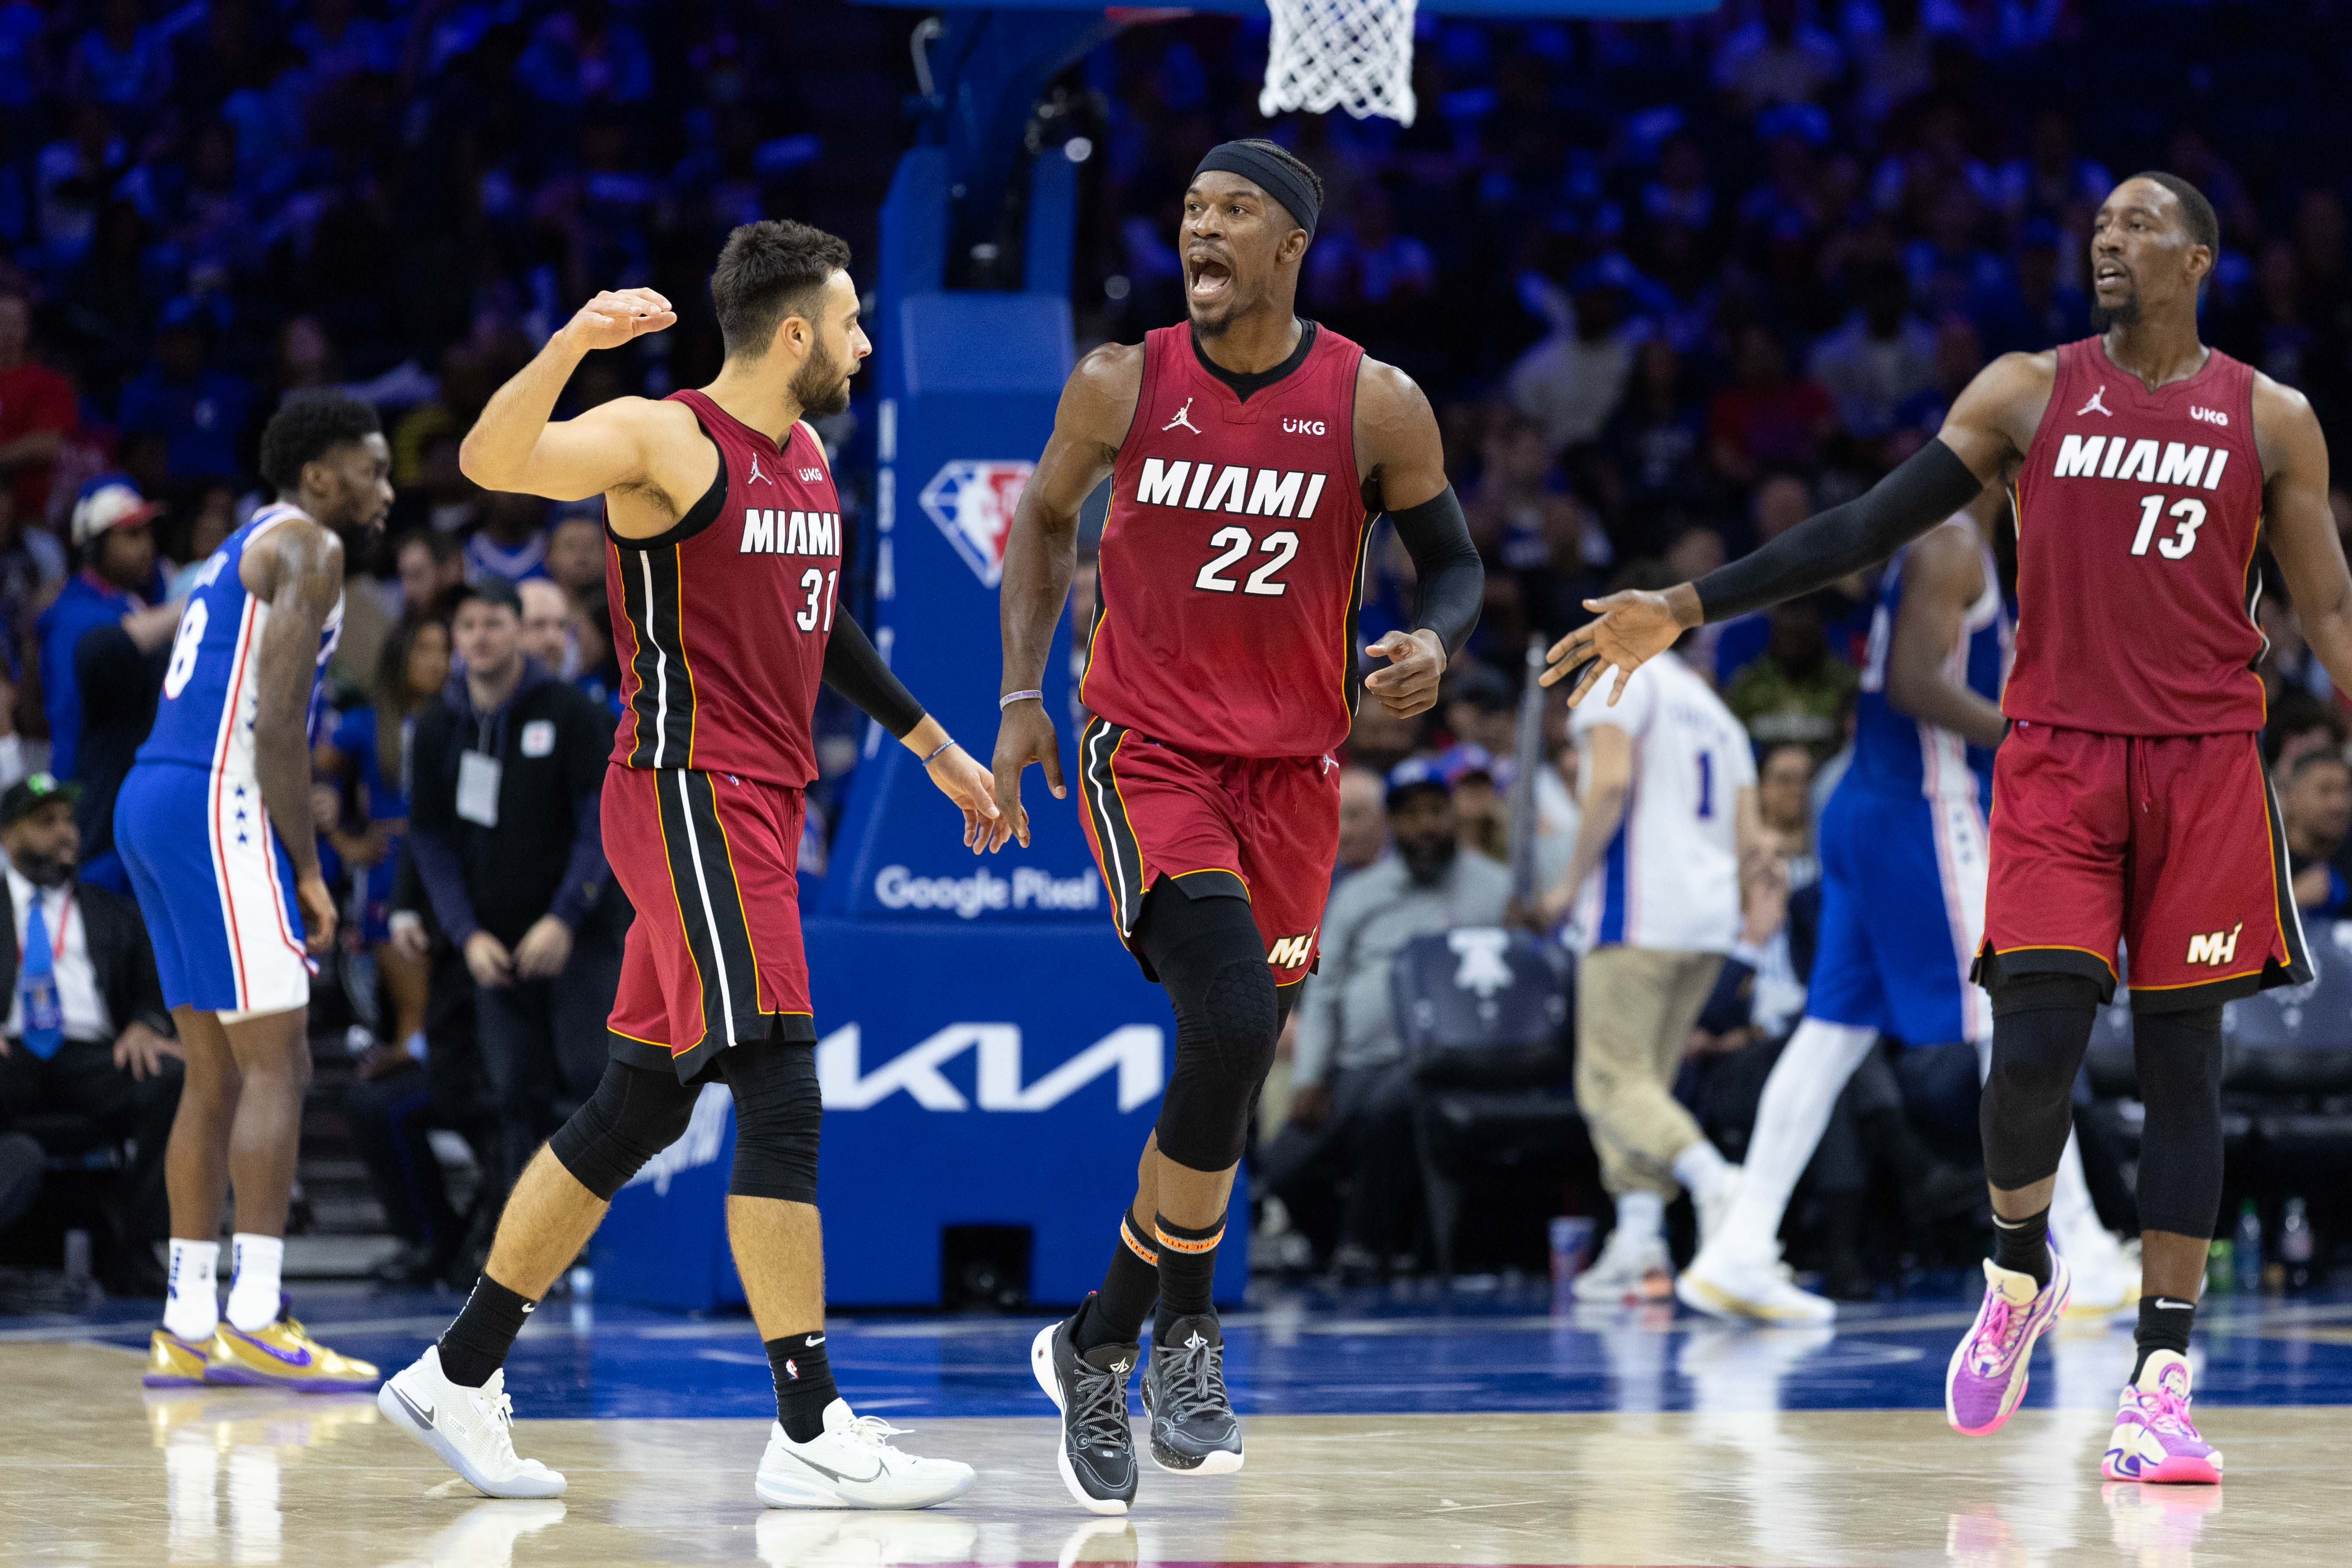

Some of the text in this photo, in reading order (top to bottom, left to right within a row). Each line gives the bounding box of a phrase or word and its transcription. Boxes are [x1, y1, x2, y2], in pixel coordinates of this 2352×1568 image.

[1136, 456, 1328, 521] MIAMI
[2053, 434, 2229, 491] MIAMI
[739, 508, 840, 557] MIAMI
[2130, 494, 2207, 560] 13
[1193, 524, 1300, 598] 22
[795, 567, 837, 633] 31
[874, 864, 1098, 919] Google Pixel
